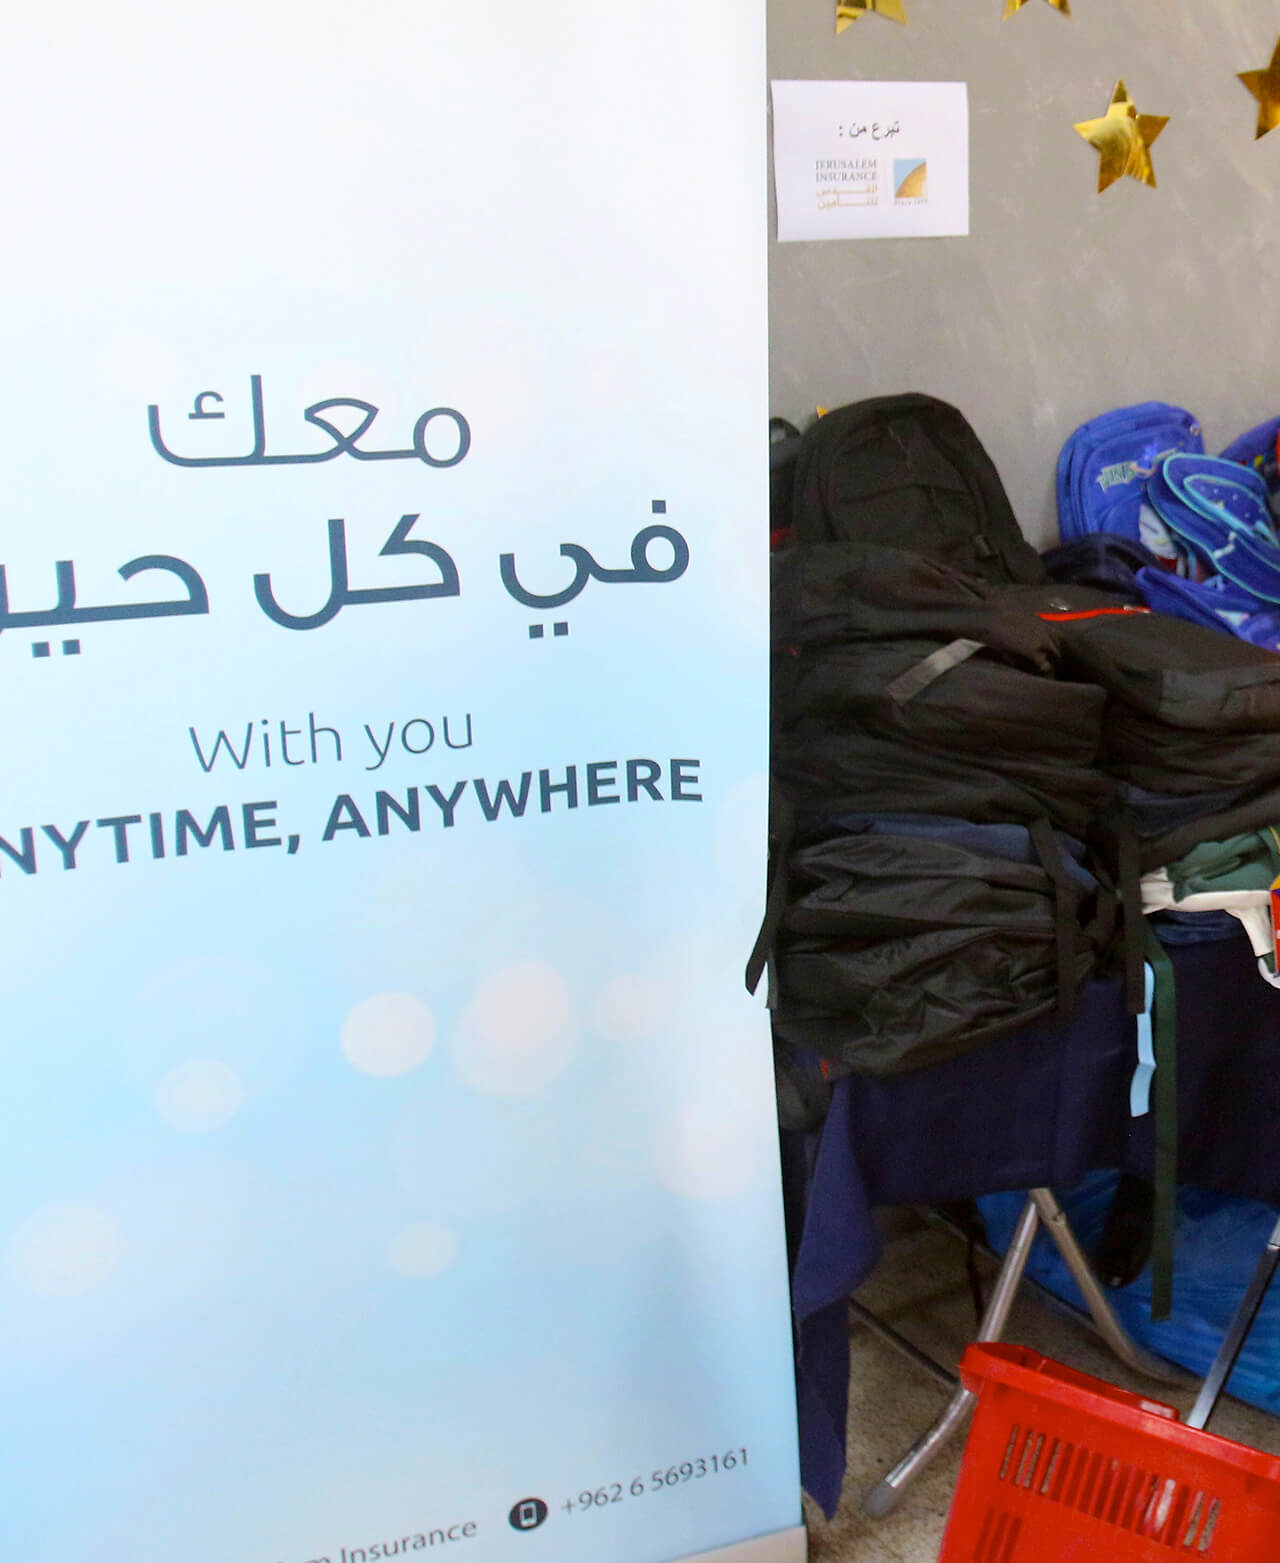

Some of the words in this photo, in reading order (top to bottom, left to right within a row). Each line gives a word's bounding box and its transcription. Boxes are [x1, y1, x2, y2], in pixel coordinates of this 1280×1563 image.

[849, 122, 868, 138] من
[871, 120, 900, 141] تبرع
[815, 159, 878, 171] JERUSALEM
[815, 171, 878, 183] INSURANCE
[147, 374, 472, 469] معك
[253, 513, 461, 631] كل
[499, 499, 691, 640] في
[0, 554, 210, 659] حي
[189, 712, 343, 773] With
[363, 712, 474, 771] you
[0, 800, 301, 879] NYTIME,
[321, 758, 704, 842] ANYWHERE
[561, 1482, 624, 1514] +962
[630, 1475, 645, 1497] 6
[650, 1447, 749, 1492] 5693161
[340, 1520, 477, 1563] Insurance
